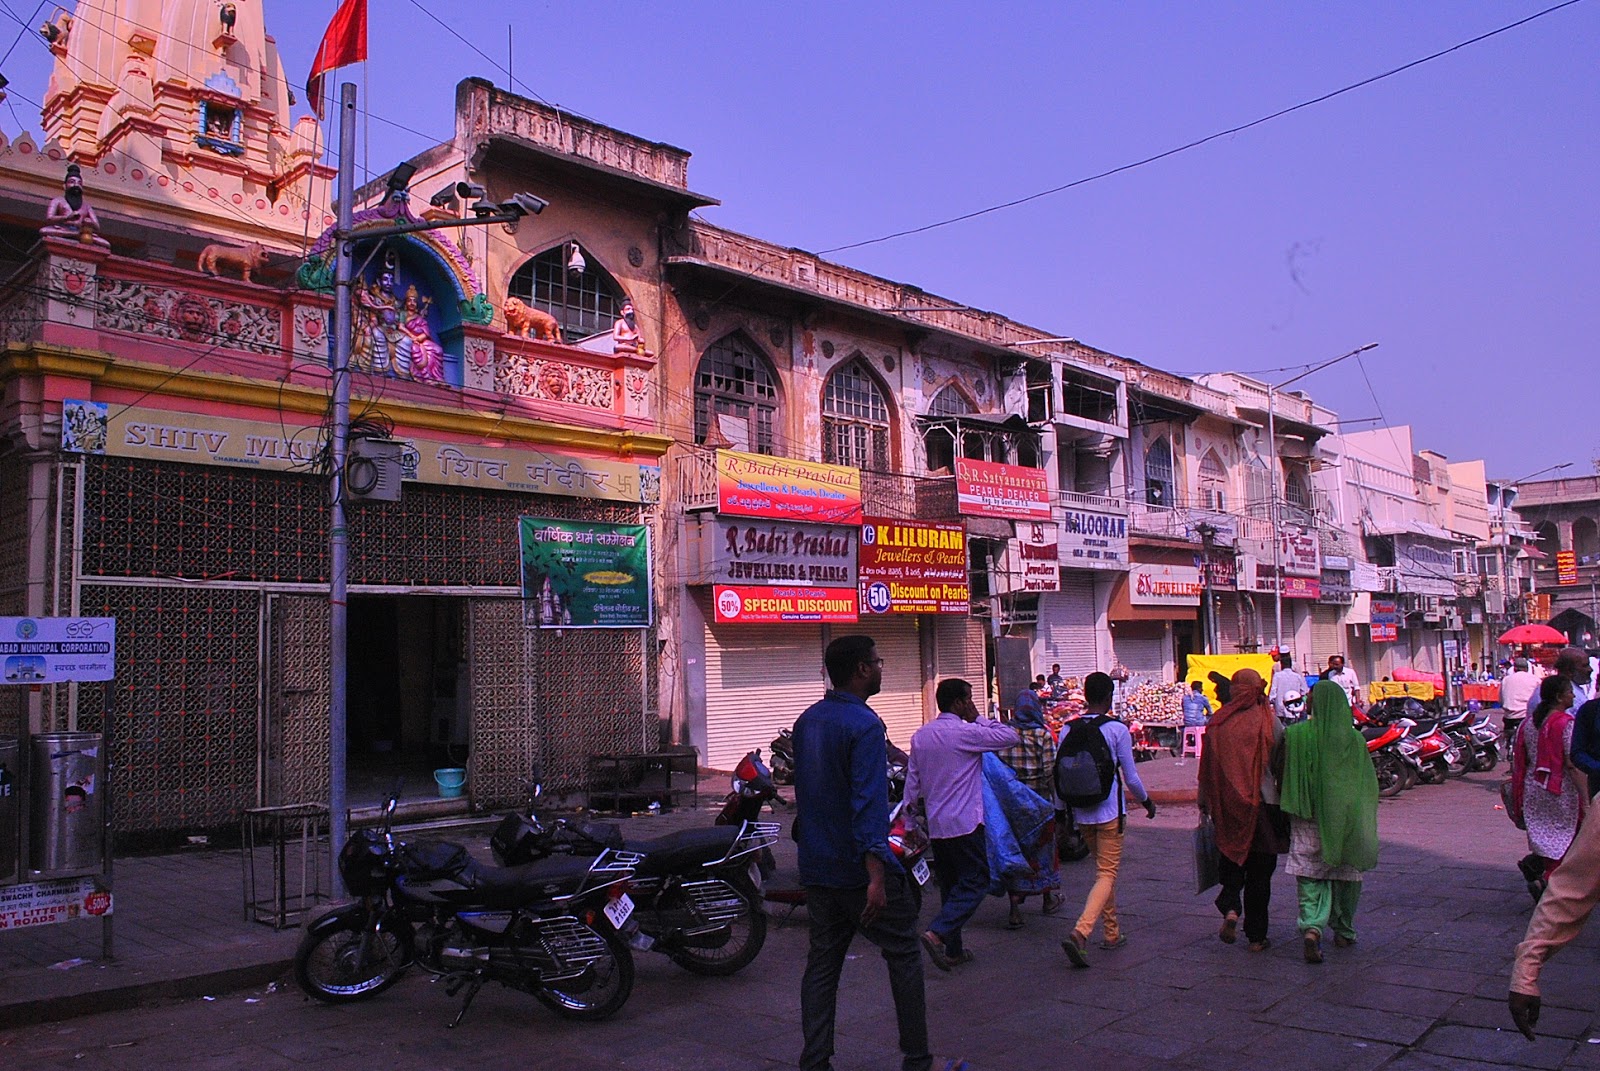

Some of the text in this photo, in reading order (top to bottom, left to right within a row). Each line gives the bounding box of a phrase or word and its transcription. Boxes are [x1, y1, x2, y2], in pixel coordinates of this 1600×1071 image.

[125, 422, 228, 454] SHIV
[212, 455, 260, 465] CHARKAMAN
[437, 446, 508, 482] शिव
[794, 467, 854, 486] Prashad
[971, 468, 1046, 493] R.Satyanarayan
[737, 480, 846, 500] Jewellers & Pearls Dealer
[970, 484, 1040, 501] PEARLS DEALER
[1065, 511, 1125, 539] KALOORAM
[534, 526, 636, 547] वार्षिक धर्म सम्मेलन
[793, 530, 849, 556] Prashad
[877, 525, 963, 549] K.LILURAM
[874, 548, 921, 563] Jewellers
[936, 551, 965, 564] Pearls
[728, 561, 848, 581] JEWELLERS & PEARLS
[1025, 562, 1055, 577] Jewellers
[890, 583, 968, 600] Discount on Pearls
[1153, 581, 1202, 595] JEWELLERS
[721, 600, 739, 612] 50%
[744, 599, 852, 612] SPECIAL DISCOUNT
[20, 643, 59, 653] MUNICIPAL
[60, 643, 109, 653] CORPORATION
[1, 886, 80, 902] SWACHH CHARMINAR
[14, 914, 56, 926] ROADS
[23, 905, 66, 918] LITTER
